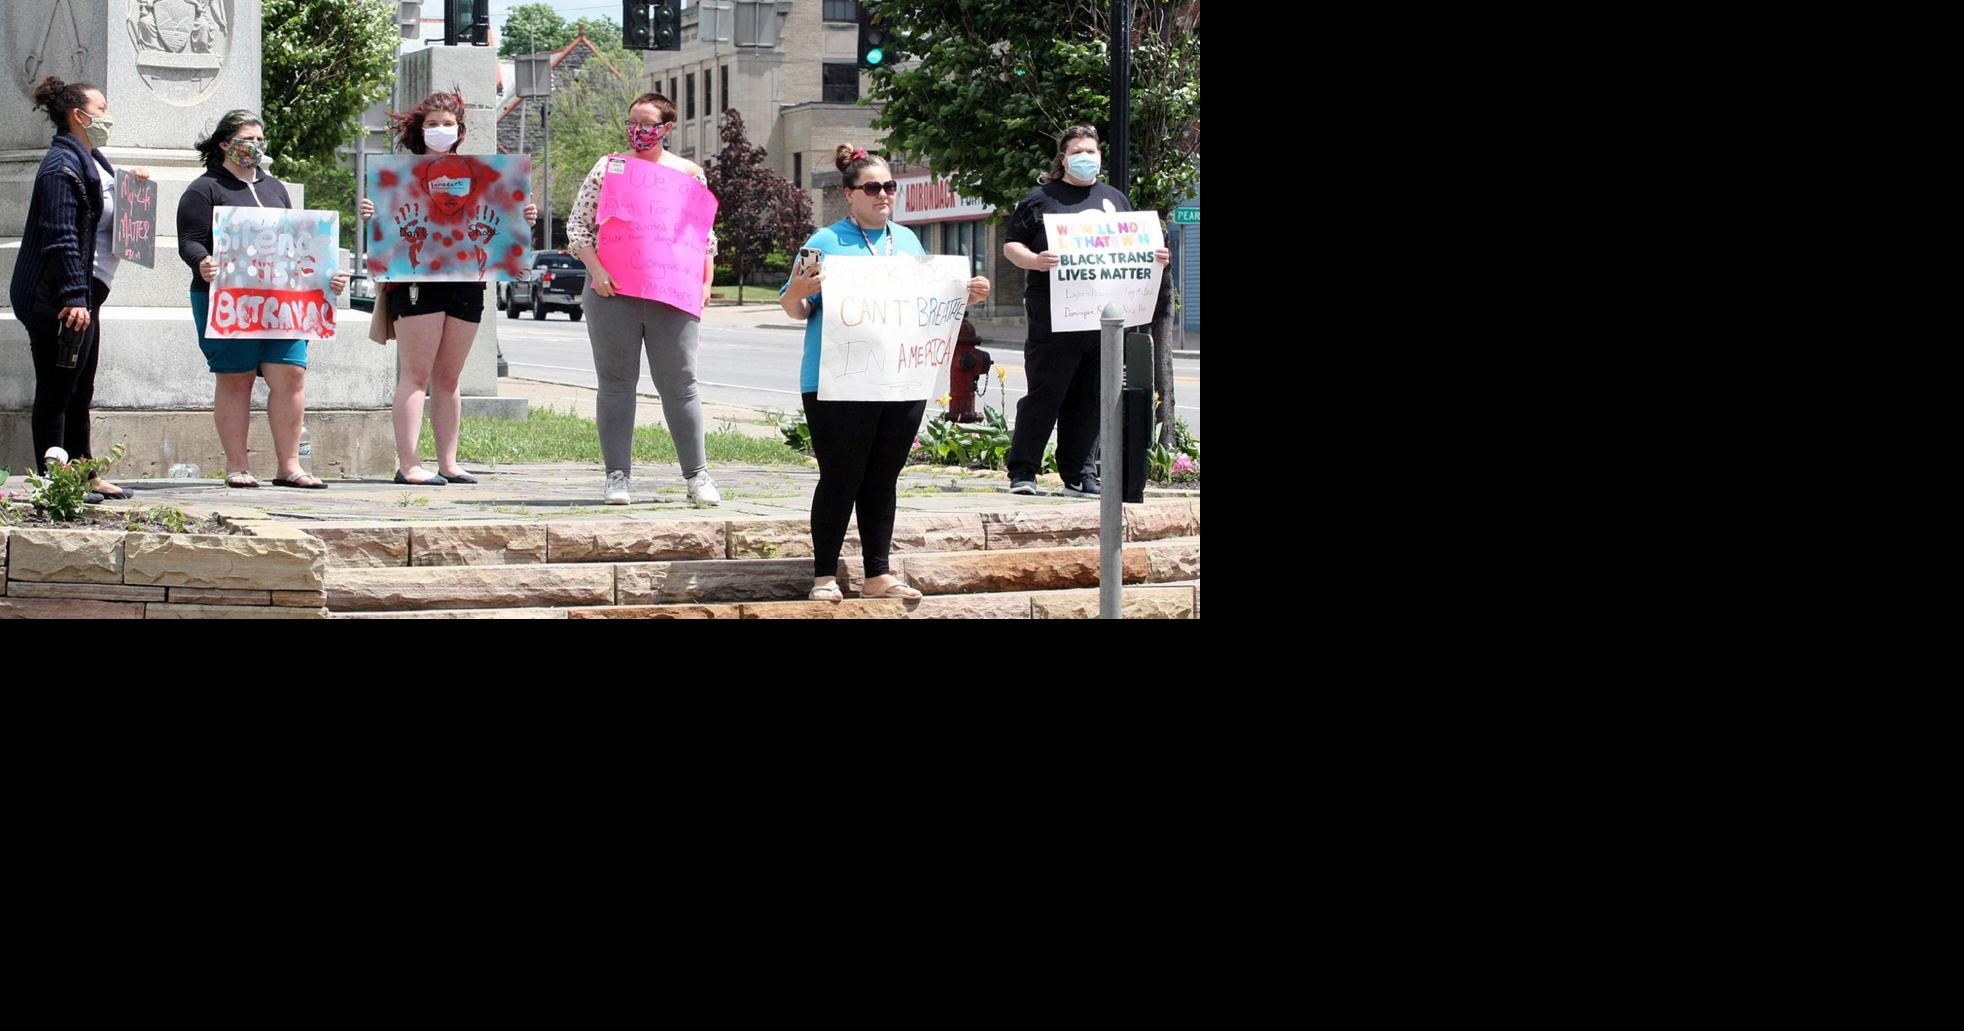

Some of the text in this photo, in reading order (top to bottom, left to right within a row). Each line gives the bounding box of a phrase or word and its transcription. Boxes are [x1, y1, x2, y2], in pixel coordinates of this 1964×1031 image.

[905, 178, 956, 212] ADIRONDACK
[1081, 223, 1115, 235] WLL
[1085, 235, 1118, 248] HAT
[1122, 233, 1151, 246] WN
[1060, 251, 1154, 266] BLACK TRANS
[1058, 267, 1151, 281] LIVES MATTER
[216, 290, 336, 330] BETRAYAL
[916, 296, 966, 327] BREATHE
[836, 336, 952, 378] IN AMERICA
